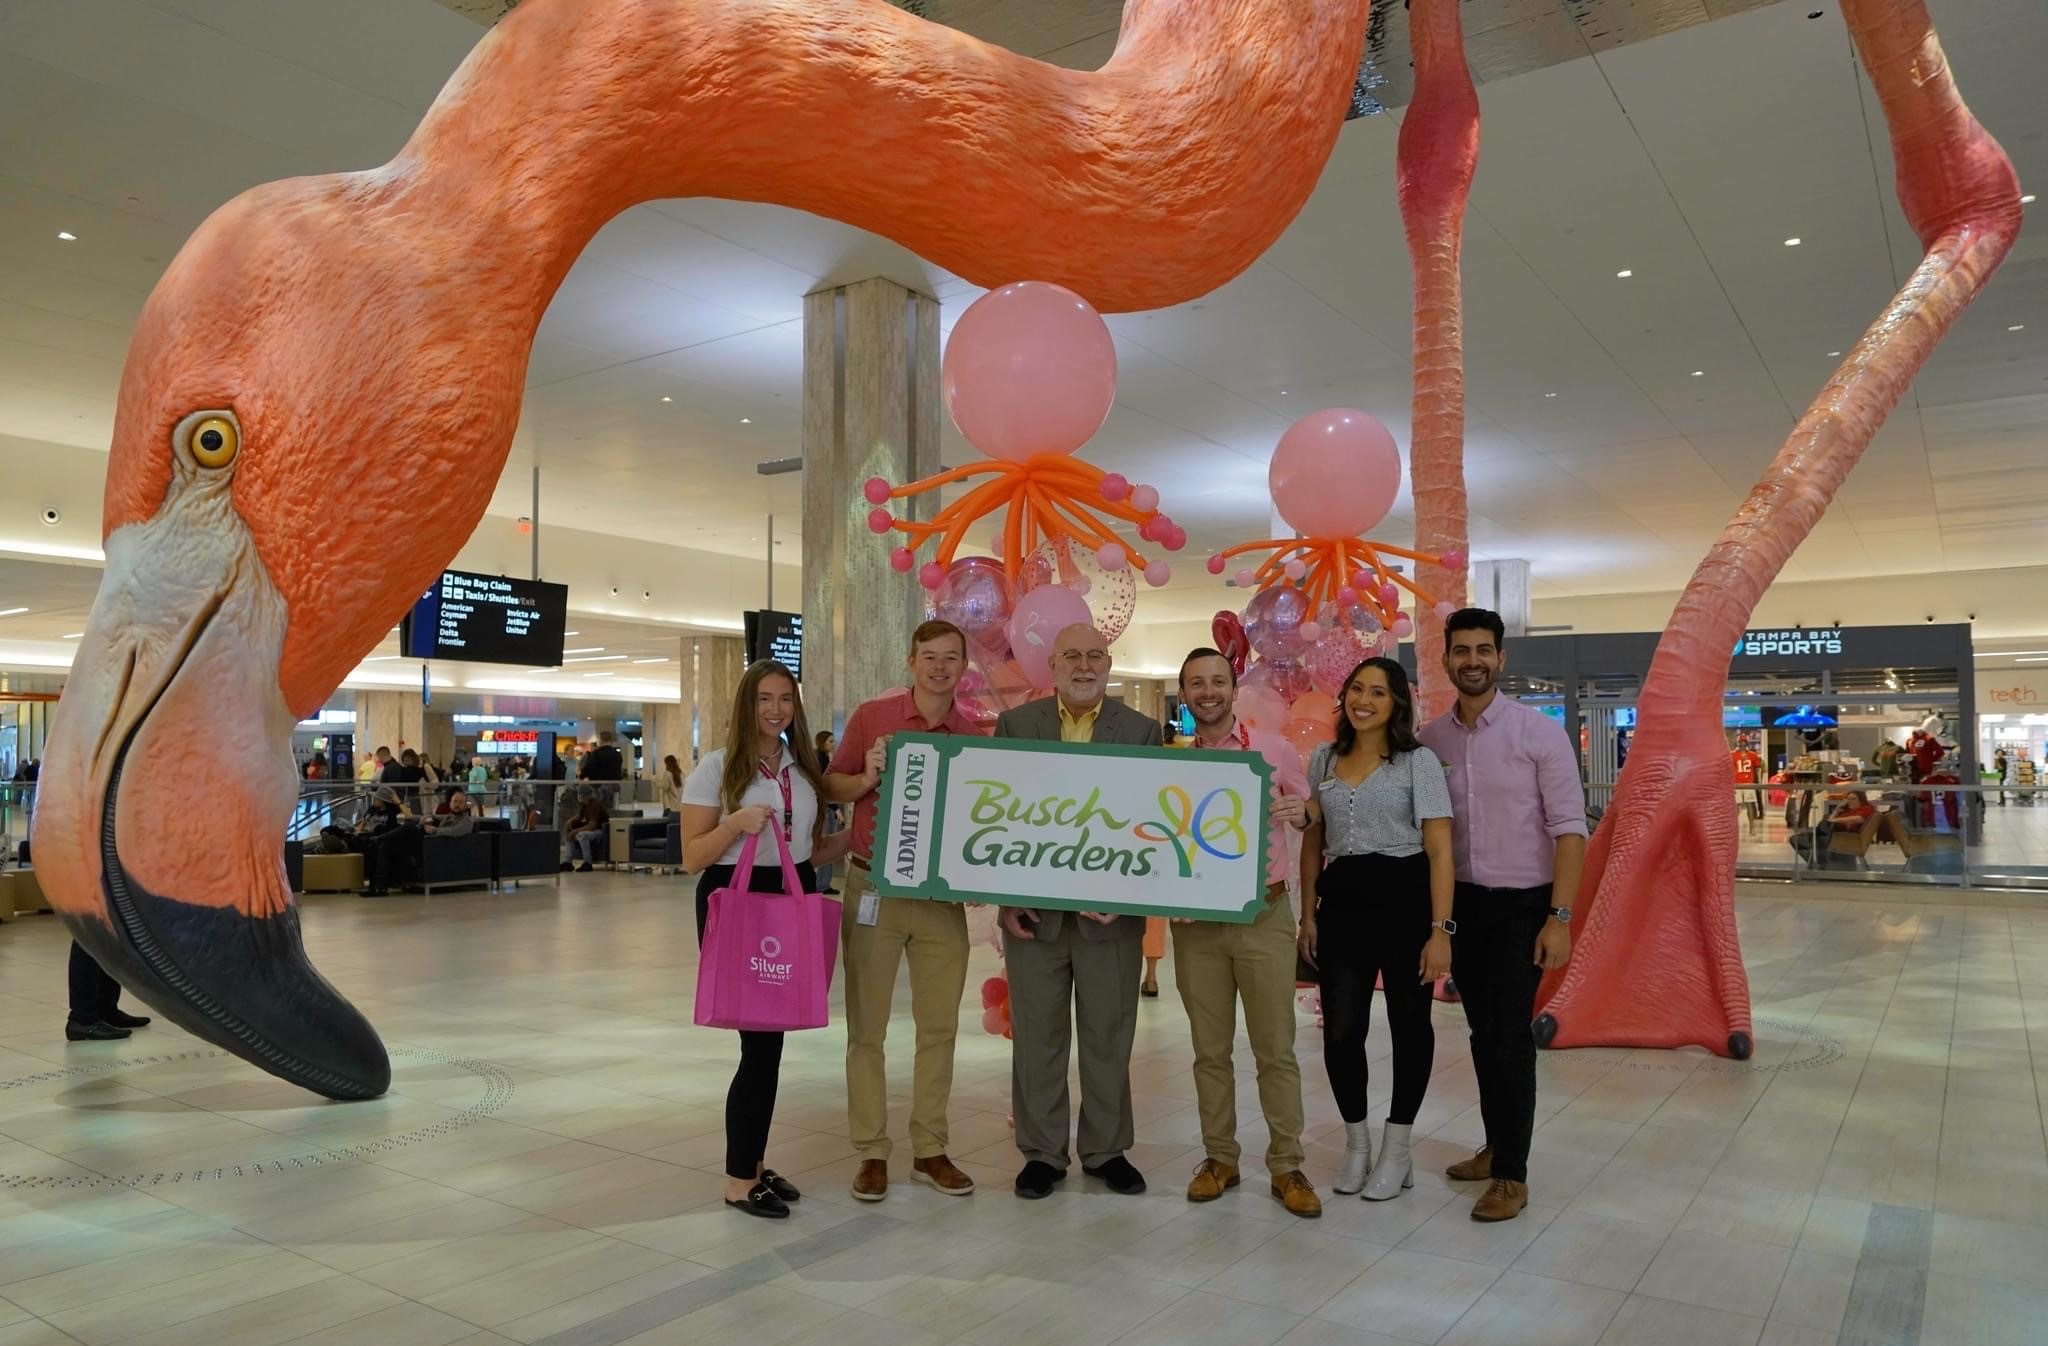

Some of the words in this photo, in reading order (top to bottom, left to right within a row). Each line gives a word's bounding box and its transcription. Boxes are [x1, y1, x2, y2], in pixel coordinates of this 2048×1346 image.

[454, 576, 472, 587] Blue
[473, 578, 488, 591] Bag
[490, 581, 512, 592] Claim
[441, 602, 474, 613] American
[440, 610, 468, 620] Cayman
[506, 609, 529, 619] Invicta
[530, 611, 541, 620] Air
[440, 619, 458, 628] Copa
[506, 618, 530, 627] JetBlue
[440, 628, 459, 637] Delta
[505, 626, 528, 635] United
[1745, 631, 1801, 641] TAMPA
[1809, 630, 1841, 640] BAY
[438, 637, 466, 647] Frontier
[1745, 640, 1842, 656] SPORTS
[1736, 759, 1752, 773] 12
[904, 754, 925, 801] ONE
[963, 779, 1130, 830] Busch
[896, 805, 920, 880] ADMIT
[962, 825, 1157, 877] Gardens
[750, 956, 793, 975] Silver
